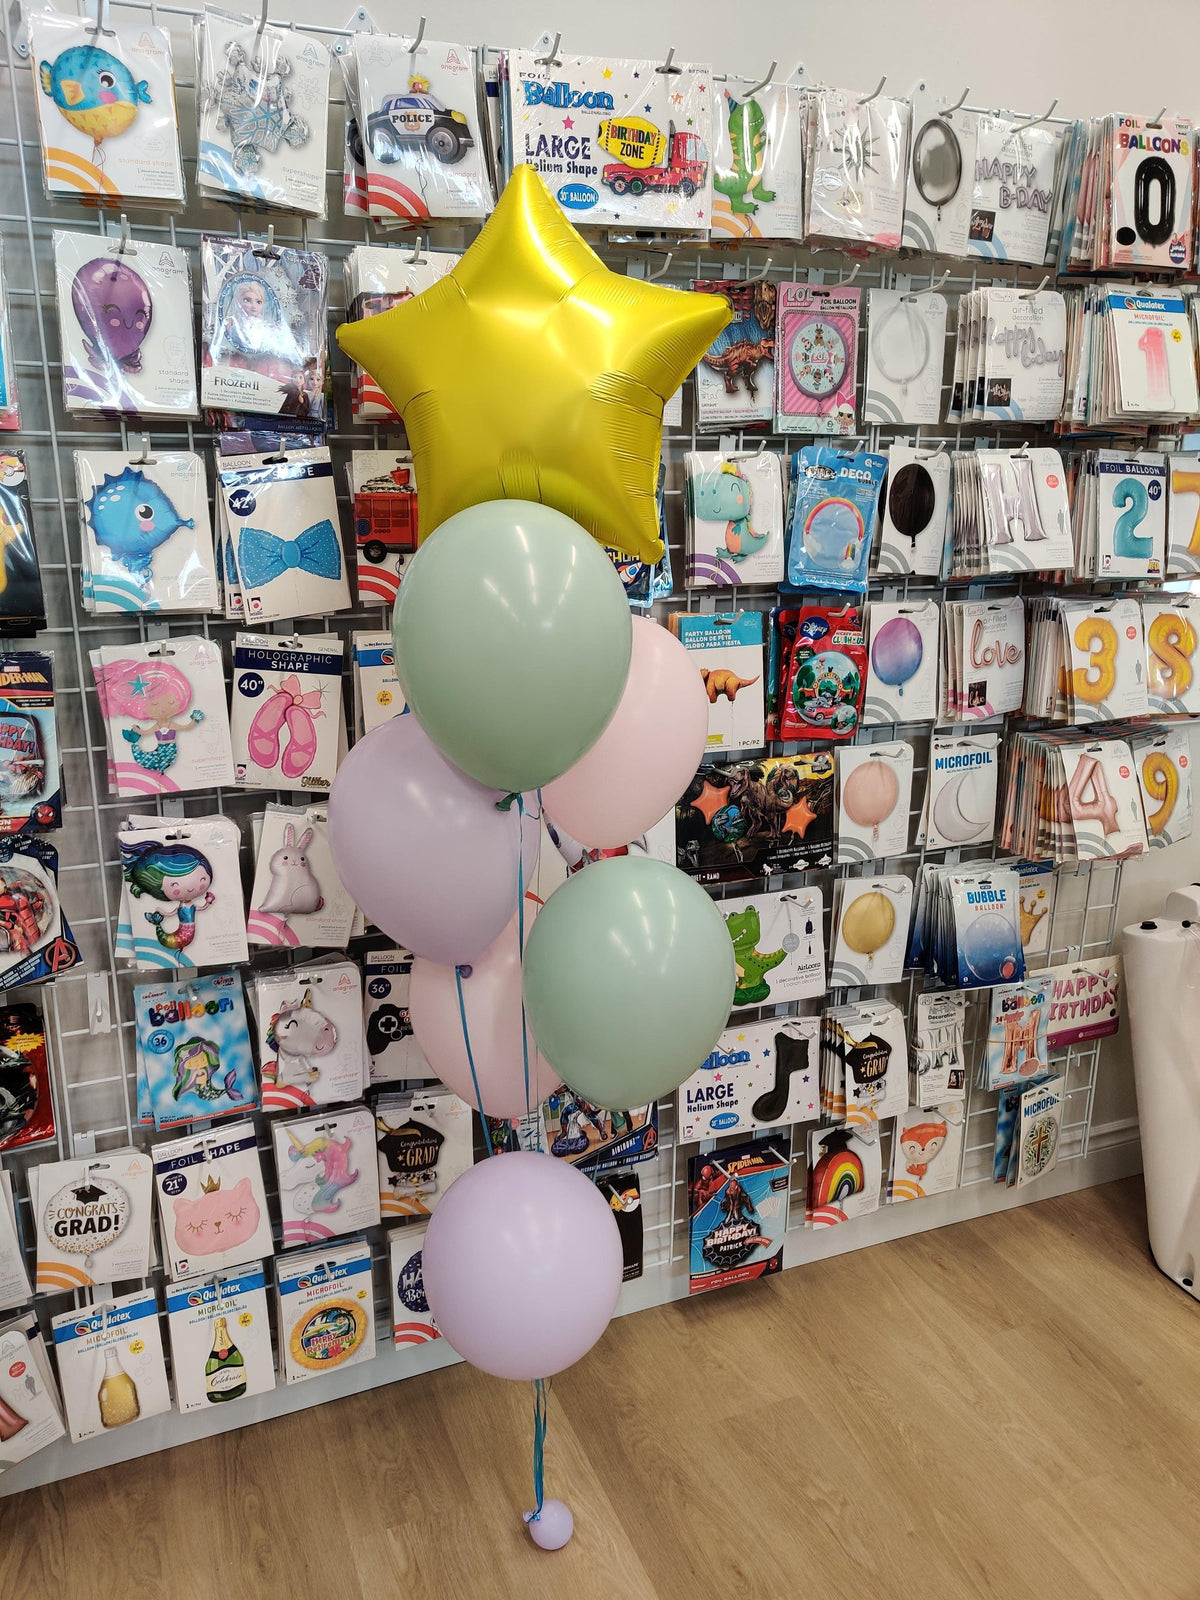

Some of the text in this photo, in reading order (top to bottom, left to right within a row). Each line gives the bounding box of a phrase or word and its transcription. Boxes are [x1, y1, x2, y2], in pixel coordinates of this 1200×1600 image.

[521, 80, 615, 110] Balloon
[392, 113, 433, 124] POLICE
[1119, 118, 1141, 129] FOIL
[611, 124, 657, 146] BIRTHDAY
[525, 133, 591, 160] LARGE
[620, 142, 645, 160] ZONE
[1119, 133, 1189, 156] BALLOONS
[566, 161, 598, 178] Shape
[975, 157, 1037, 187] HAPPY
[570, 192, 598, 202] BALLOON
[999, 185, 1053, 213] B-DAY
[1134, 155, 1176, 248] 0
[787, 288, 815, 302] LOL
[1135, 300, 1166, 310] Qualatex
[158, 369, 189, 377] standard
[169, 377, 189, 385] shape
[214, 376, 260, 391] FROZEN II
[223, 460, 251, 468] BALLOON
[1105, 464, 1160, 475] FOIL BALLOON
[273, 466, 314, 480] SPE
[840, 467, 871, 480] DECO
[1148, 485, 1161, 494] 40"
[1112, 478, 1153, 559] 2
[803, 621, 828, 637] Disney
[833, 635, 865, 645] CLUBHOUS
[970, 619, 1022, 669] love
[248, 650, 333, 665] HOLOGRAPHIC
[1074, 614, 1118, 708] 3
[1148, 612, 1198, 700] 8
[271, 661, 310, 672] SHAPE
[0, 672, 48, 687] DER-MAN
[240, 679, 263, 691] 40"
[935, 751, 992, 771] MICROFOIL
[1068, 753, 1122, 836] 4
[707, 872, 720, 880] RAMO
[967, 889, 1007, 904] BUBBLE
[974, 903, 1004, 911] BALLOON
[381, 965, 405, 973] FOIL
[371, 984, 390, 994] 36"
[1052, 969, 1109, 1000] HAPPY
[155, 1000, 177, 1012] foil
[1002, 993, 1045, 1013] balloon
[1049, 985, 1119, 1022] IRTHDAY
[148, 997, 234, 1027] balloon
[154, 1036, 168, 1047] 36
[700, 1051, 751, 1070] lloon
[866, 1056, 888, 1078] GRAD
[686, 1082, 734, 1104] LARGE
[687, 1099, 739, 1113] Helium Shape
[1024, 1093, 1060, 1118] MICROFOIL
[719, 1117, 737, 1125] BALLOON
[157, 1146, 184, 1158] BALLOON
[171, 1143, 241, 1169] FOIL SHAPE
[406, 1146, 436, 1168] GRAD
[727, 1156, 764, 1174] SPIDER-MAN
[165, 1177, 184, 1192] 21"
[57, 1202, 119, 1219] CONGRATS
[53, 1214, 120, 1239] GRAD!
[714, 1223, 748, 1237] HAPPY
[706, 1227, 757, 1247] BIRTHDAY!
[719, 1241, 743, 1252] PATRICK
[311, 1267, 348, 1284] Quatex
[306, 1281, 344, 1298] MICROFOIL
[197, 1299, 238, 1316] MICROOIL
[90, 1311, 132, 1330] Qulatex
[306, 1334, 354, 1355] Retirement
[210, 1372, 243, 1388] Celebrate
